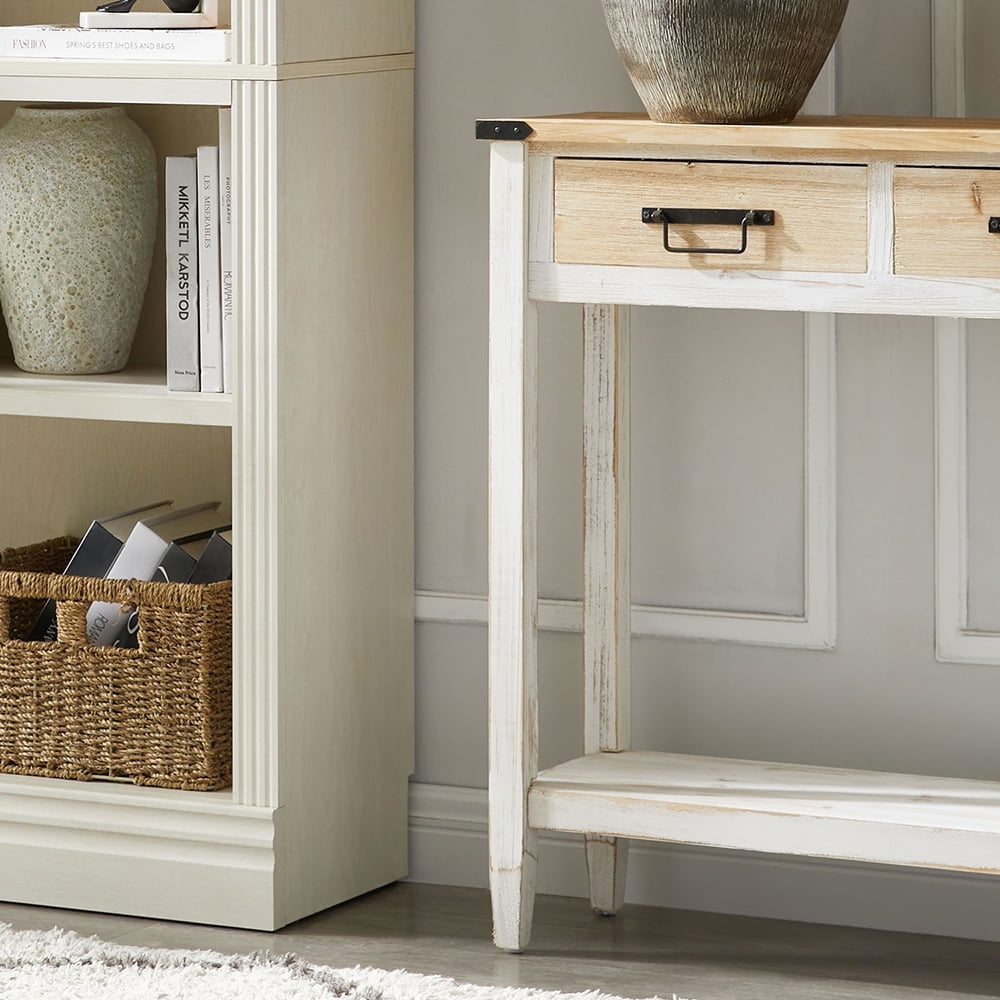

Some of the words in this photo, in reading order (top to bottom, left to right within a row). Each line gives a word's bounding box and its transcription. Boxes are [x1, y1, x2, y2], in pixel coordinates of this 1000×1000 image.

[12, 39, 47, 49] FASHION
[97, 41, 113, 49] BEST
[114, 41, 138, 50] SHOES
[139, 42, 155, 50] AND
[156, 42, 175, 50] BAGS
[203, 174, 211, 190] LES
[178, 185, 190, 248] MIKKETL
[203, 195, 212, 249] MISERABLES
[178, 252, 190, 321] KARSTOD
